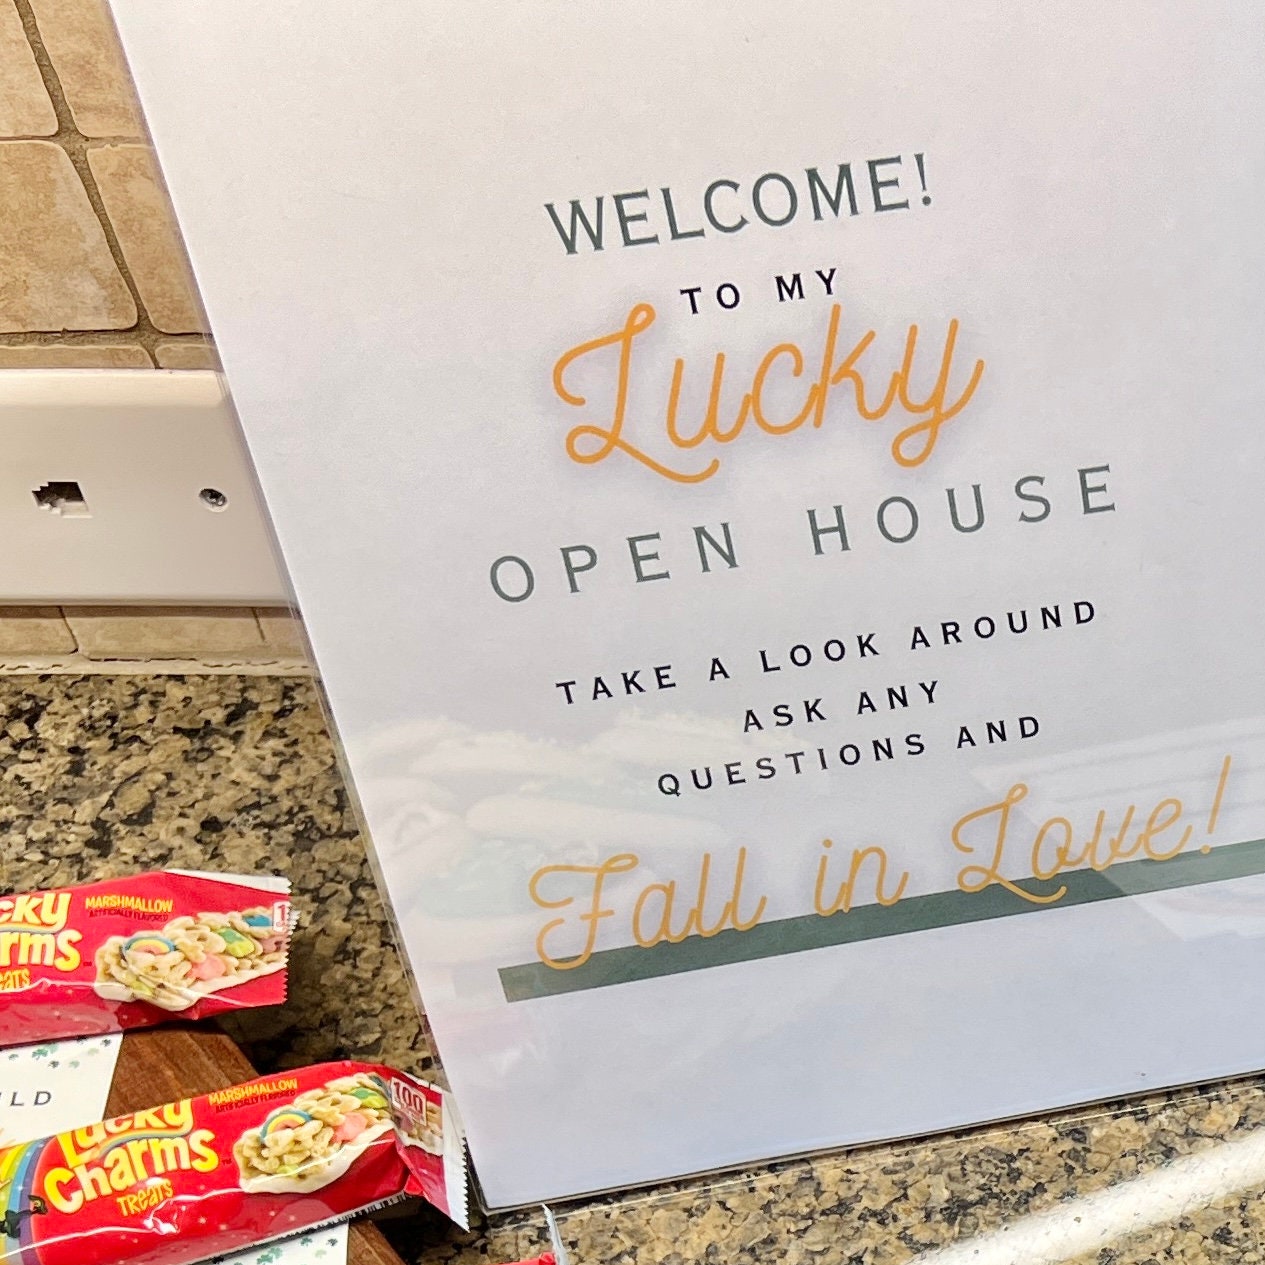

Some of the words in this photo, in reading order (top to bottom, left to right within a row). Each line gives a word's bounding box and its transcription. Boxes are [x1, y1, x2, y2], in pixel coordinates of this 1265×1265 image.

[545, 153, 934, 256] WELCOME!
[682, 284, 740, 315] TO
[775, 267, 838, 303] MY
[552, 302, 985, 484] Lucky
[489, 522, 740, 603] OPEN
[807, 464, 1117, 556] HOUSE
[555, 664, 678, 706] TAKE
[708, 657, 731, 682] A
[759, 632, 880, 674] LOOK
[909, 599, 1097, 651] AROUND
[742, 695, 828, 733] ASK
[856, 680, 941, 716] ANY
[657, 732, 928, 799] QUESTIONS
[956, 715, 1042, 749] AND
[85, 895, 174, 913] MARSHMALLOW
[529, 847, 765, 971] Fall
[812, 838, 909, 913] in
[952, 754, 1232, 903] Love!
[208, 1078, 298, 1106] MARSHMALLOW
[392, 1081, 425, 1113] 100
[44, 1129, 219, 1214] Charms
